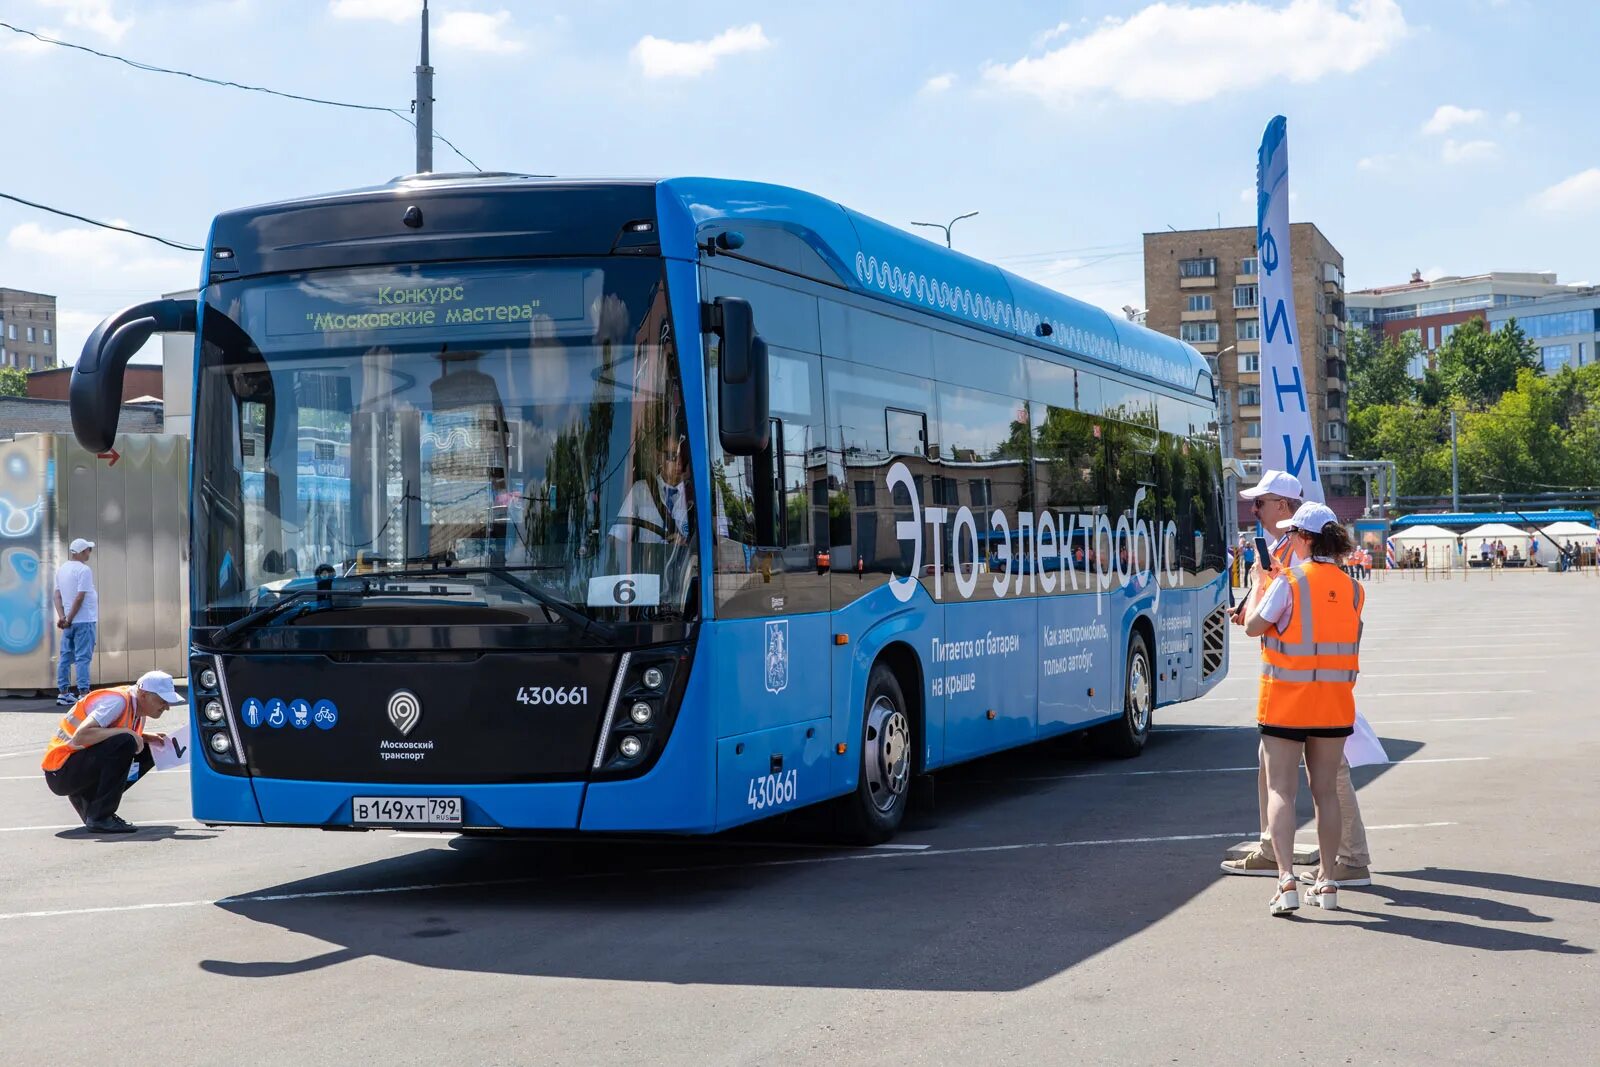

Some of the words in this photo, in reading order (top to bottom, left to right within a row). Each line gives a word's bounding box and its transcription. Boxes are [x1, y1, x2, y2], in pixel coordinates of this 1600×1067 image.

[378, 286, 464, 305] Конкурс
[306, 309, 436, 331] "Московские
[445, 299, 540, 323] мастера"
[1260, 228, 1317, 482] ФИНИ
[885, 461, 979, 603] Это
[991, 485, 1185, 615] электробус.
[612, 579, 637, 605] 6
[932, 634, 974, 664] Питается
[974, 638, 985, 658] от
[986, 630, 1020, 657] батареи
[1043, 624, 1058, 647] Как
[1043, 656, 1068, 677] только
[1068, 647, 1093, 673] автобус
[516, 686, 588, 705] 430661
[932, 678, 943, 697] на
[944, 670, 976, 700] крыше
[380, 739, 434, 750] Московский
[380, 751, 425, 761] транспорт
[747, 768, 797, 810] 430661
[429, 799, 457, 815] 799
